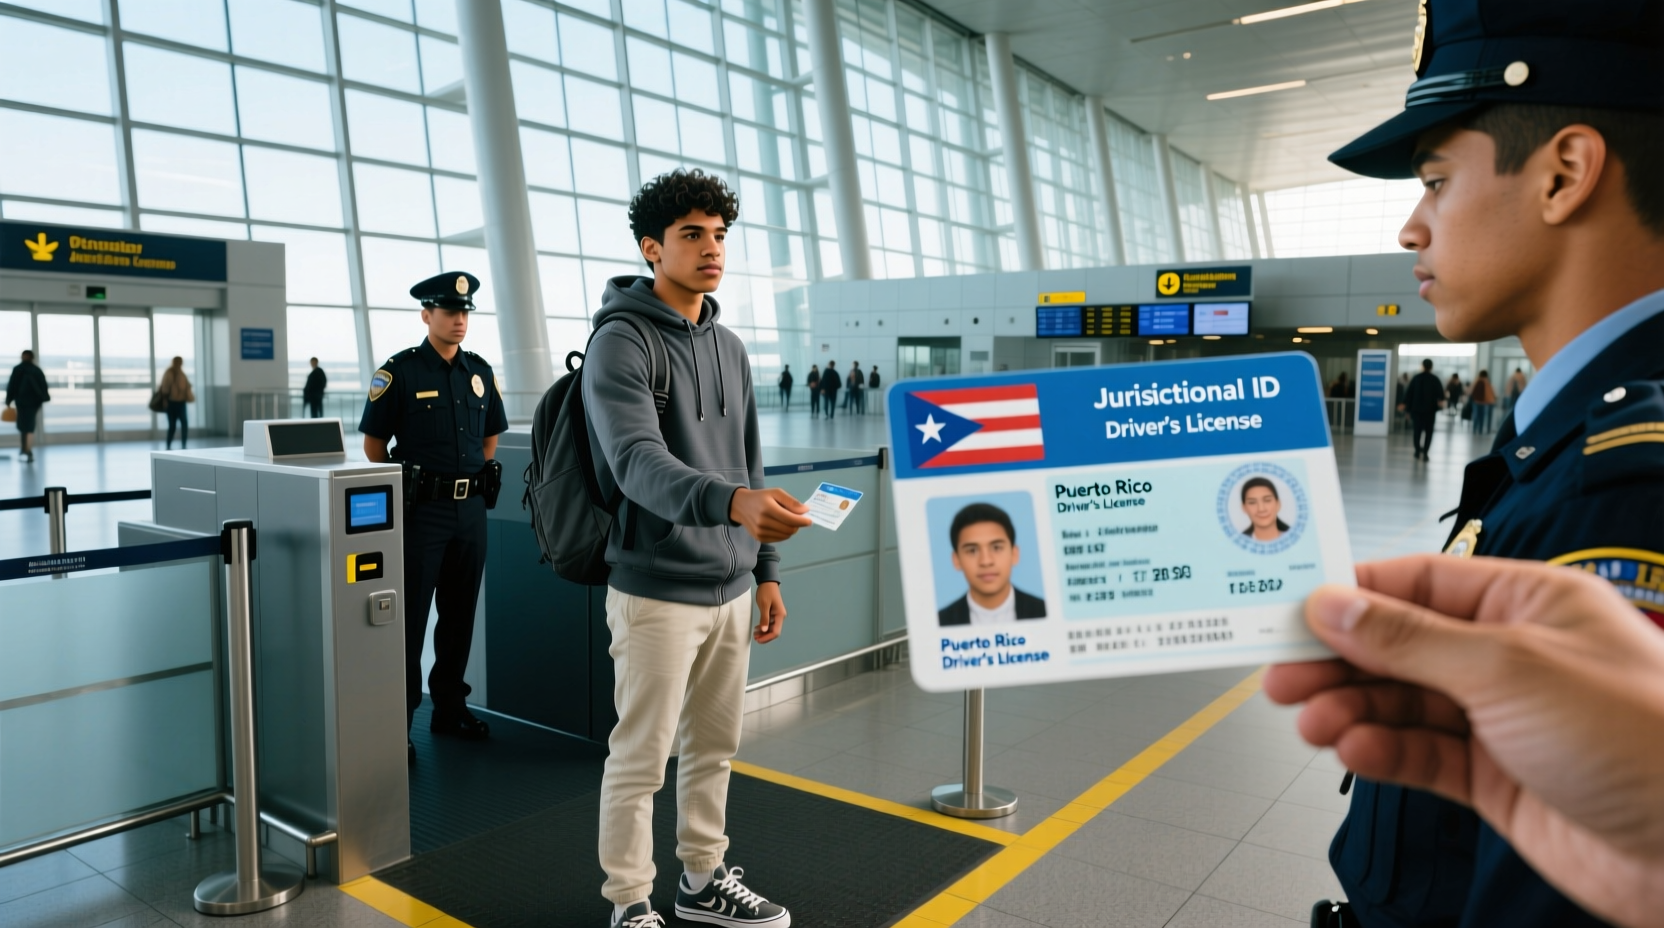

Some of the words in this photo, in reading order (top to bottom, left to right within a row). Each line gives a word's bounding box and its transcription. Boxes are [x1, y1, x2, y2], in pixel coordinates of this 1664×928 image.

[1093, 377, 1245, 409] Jurisictional
[1252, 376, 1281, 399] ID
[1105, 415, 1181, 439] Driver's
[1185, 413, 1262, 433] License
[1055, 482, 1111, 499] Puerto
[1115, 479, 1152, 495] Rico
[941, 637, 990, 652] Puerto
[995, 633, 1026, 647] Rico
